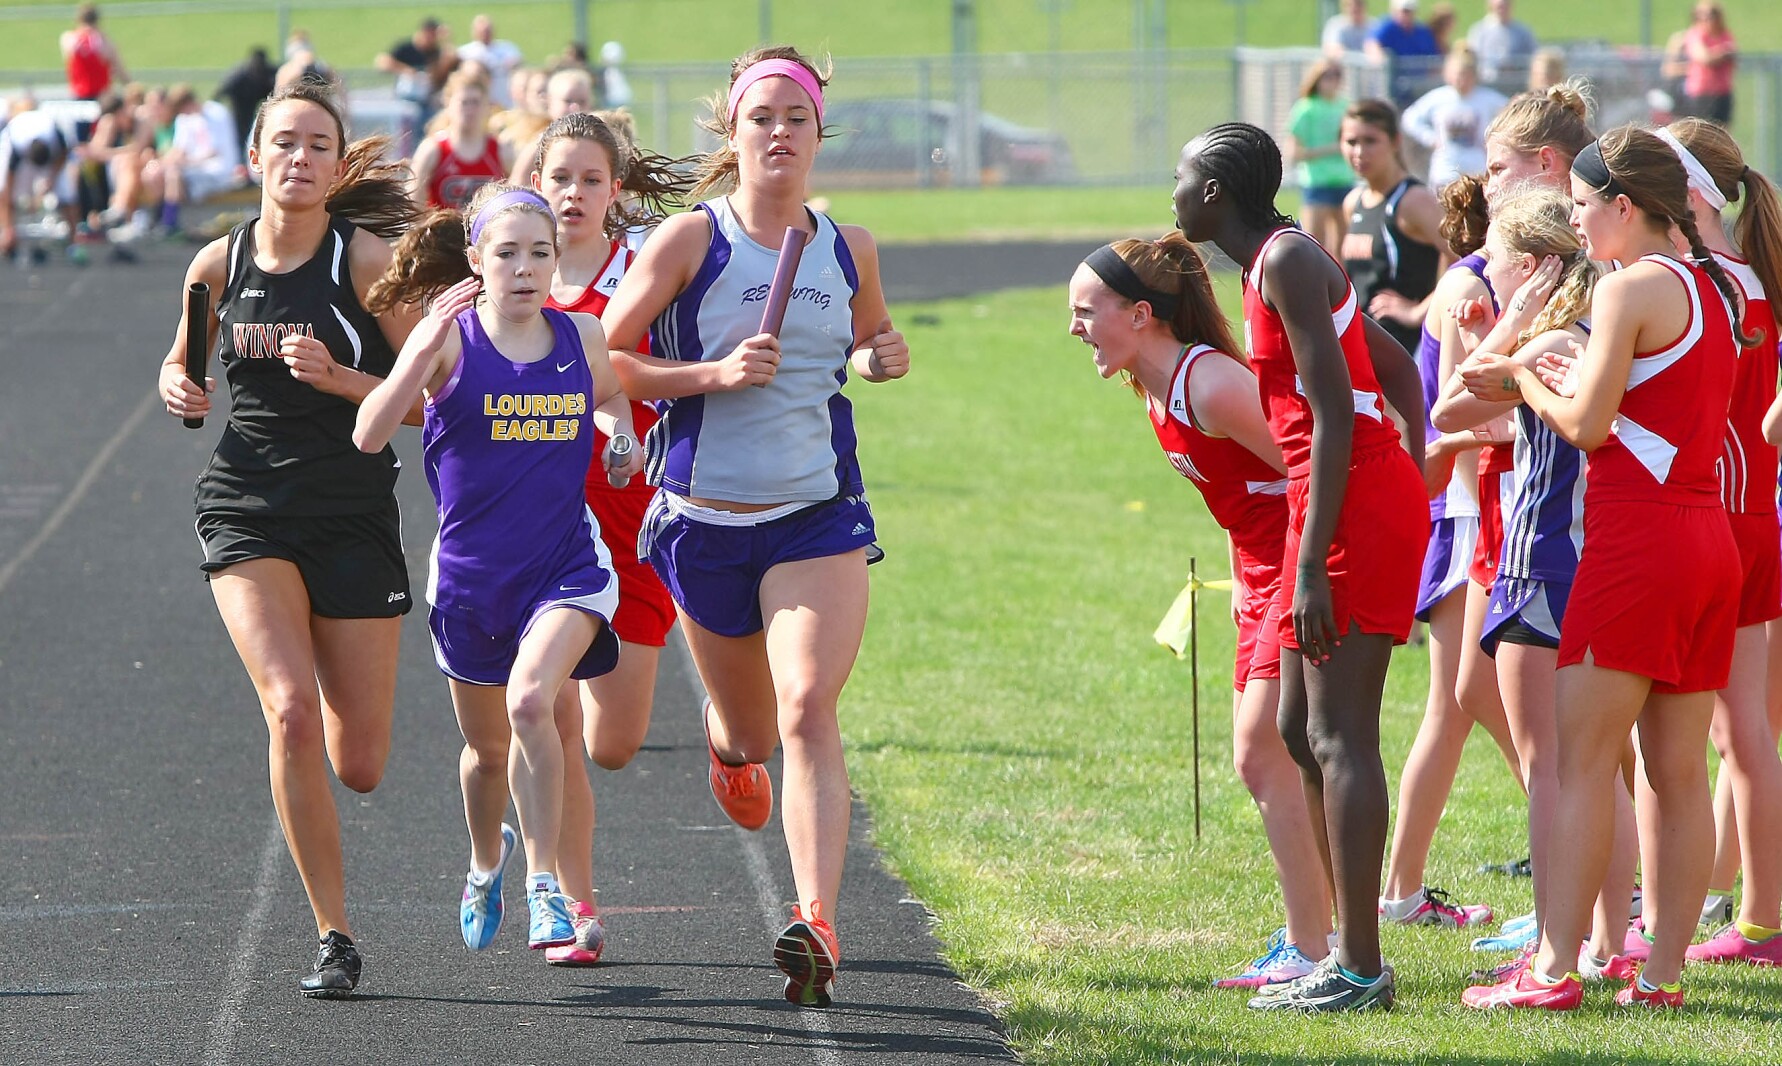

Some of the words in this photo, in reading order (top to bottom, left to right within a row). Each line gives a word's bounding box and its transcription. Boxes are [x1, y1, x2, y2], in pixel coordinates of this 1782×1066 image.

[741, 284, 771, 306] RE
[484, 392, 587, 417] LOURDES
[491, 419, 580, 442] EAGLES
